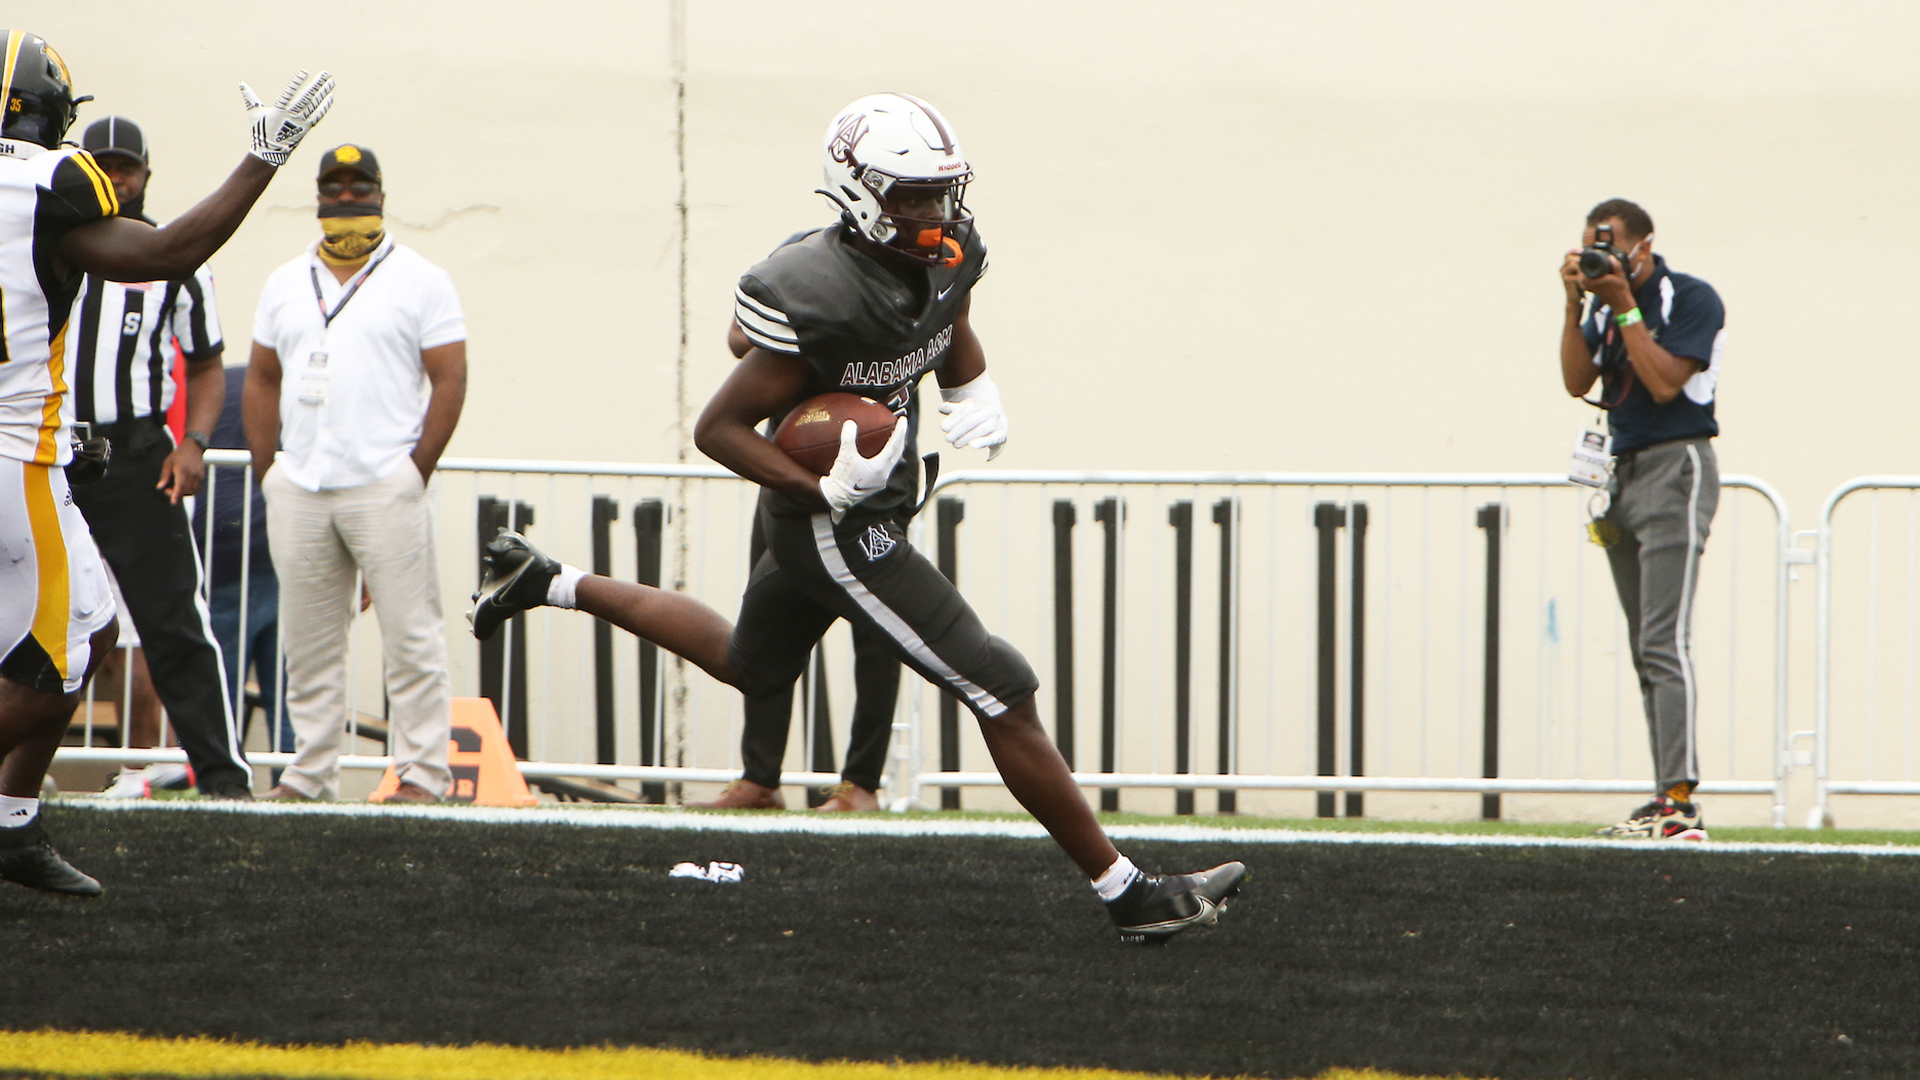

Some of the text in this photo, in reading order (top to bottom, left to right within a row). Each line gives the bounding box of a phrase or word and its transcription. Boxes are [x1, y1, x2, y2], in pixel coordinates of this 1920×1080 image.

[10, 97, 23, 112] 35
[276, 126, 303, 142] adidas
[123, 311, 141, 336] S
[839, 324, 953, 386] ALABAMA A&M
